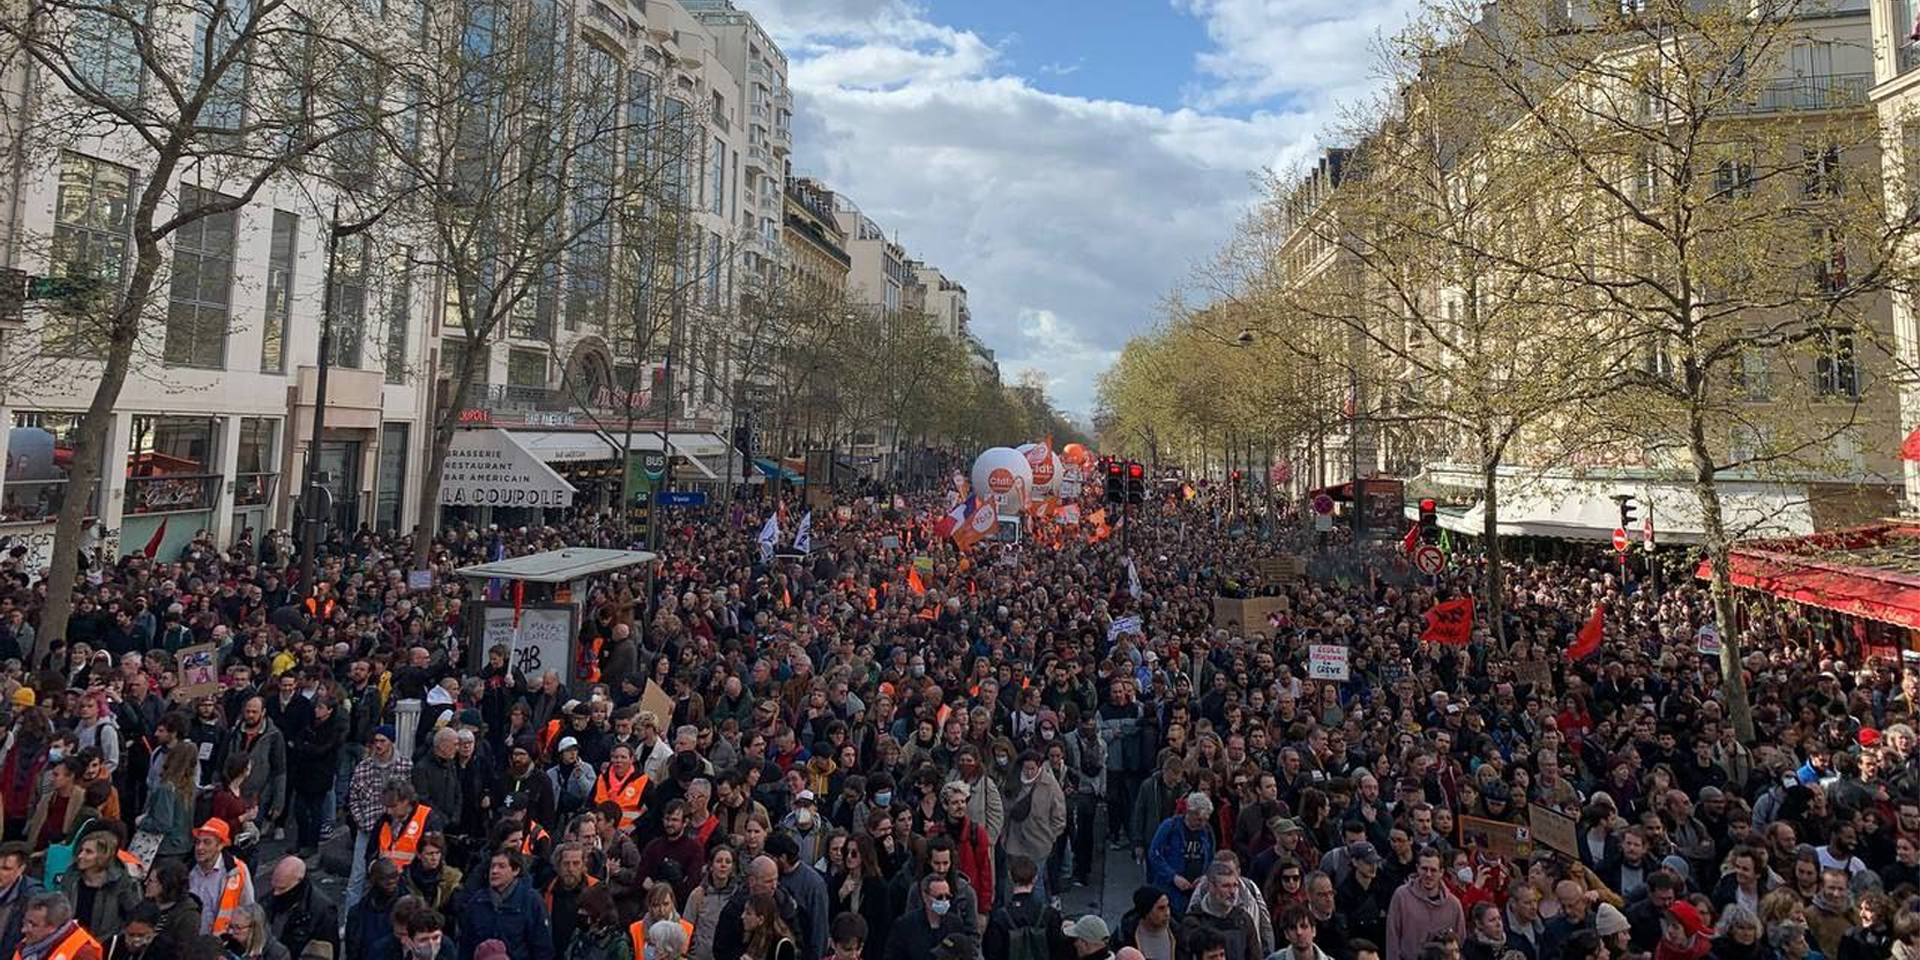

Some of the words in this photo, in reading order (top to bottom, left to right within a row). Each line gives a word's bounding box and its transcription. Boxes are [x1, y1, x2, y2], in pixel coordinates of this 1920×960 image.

[445, 449, 501, 458] BRASSERIE
[444, 461, 513, 470] RESTAURANT
[646, 455, 664, 467] BUS
[444, 473, 465, 481] BAR
[470, 473, 530, 483] AMERICAIN
[442, 487, 466, 503] LA
[472, 488, 563, 505] COUPOLE
